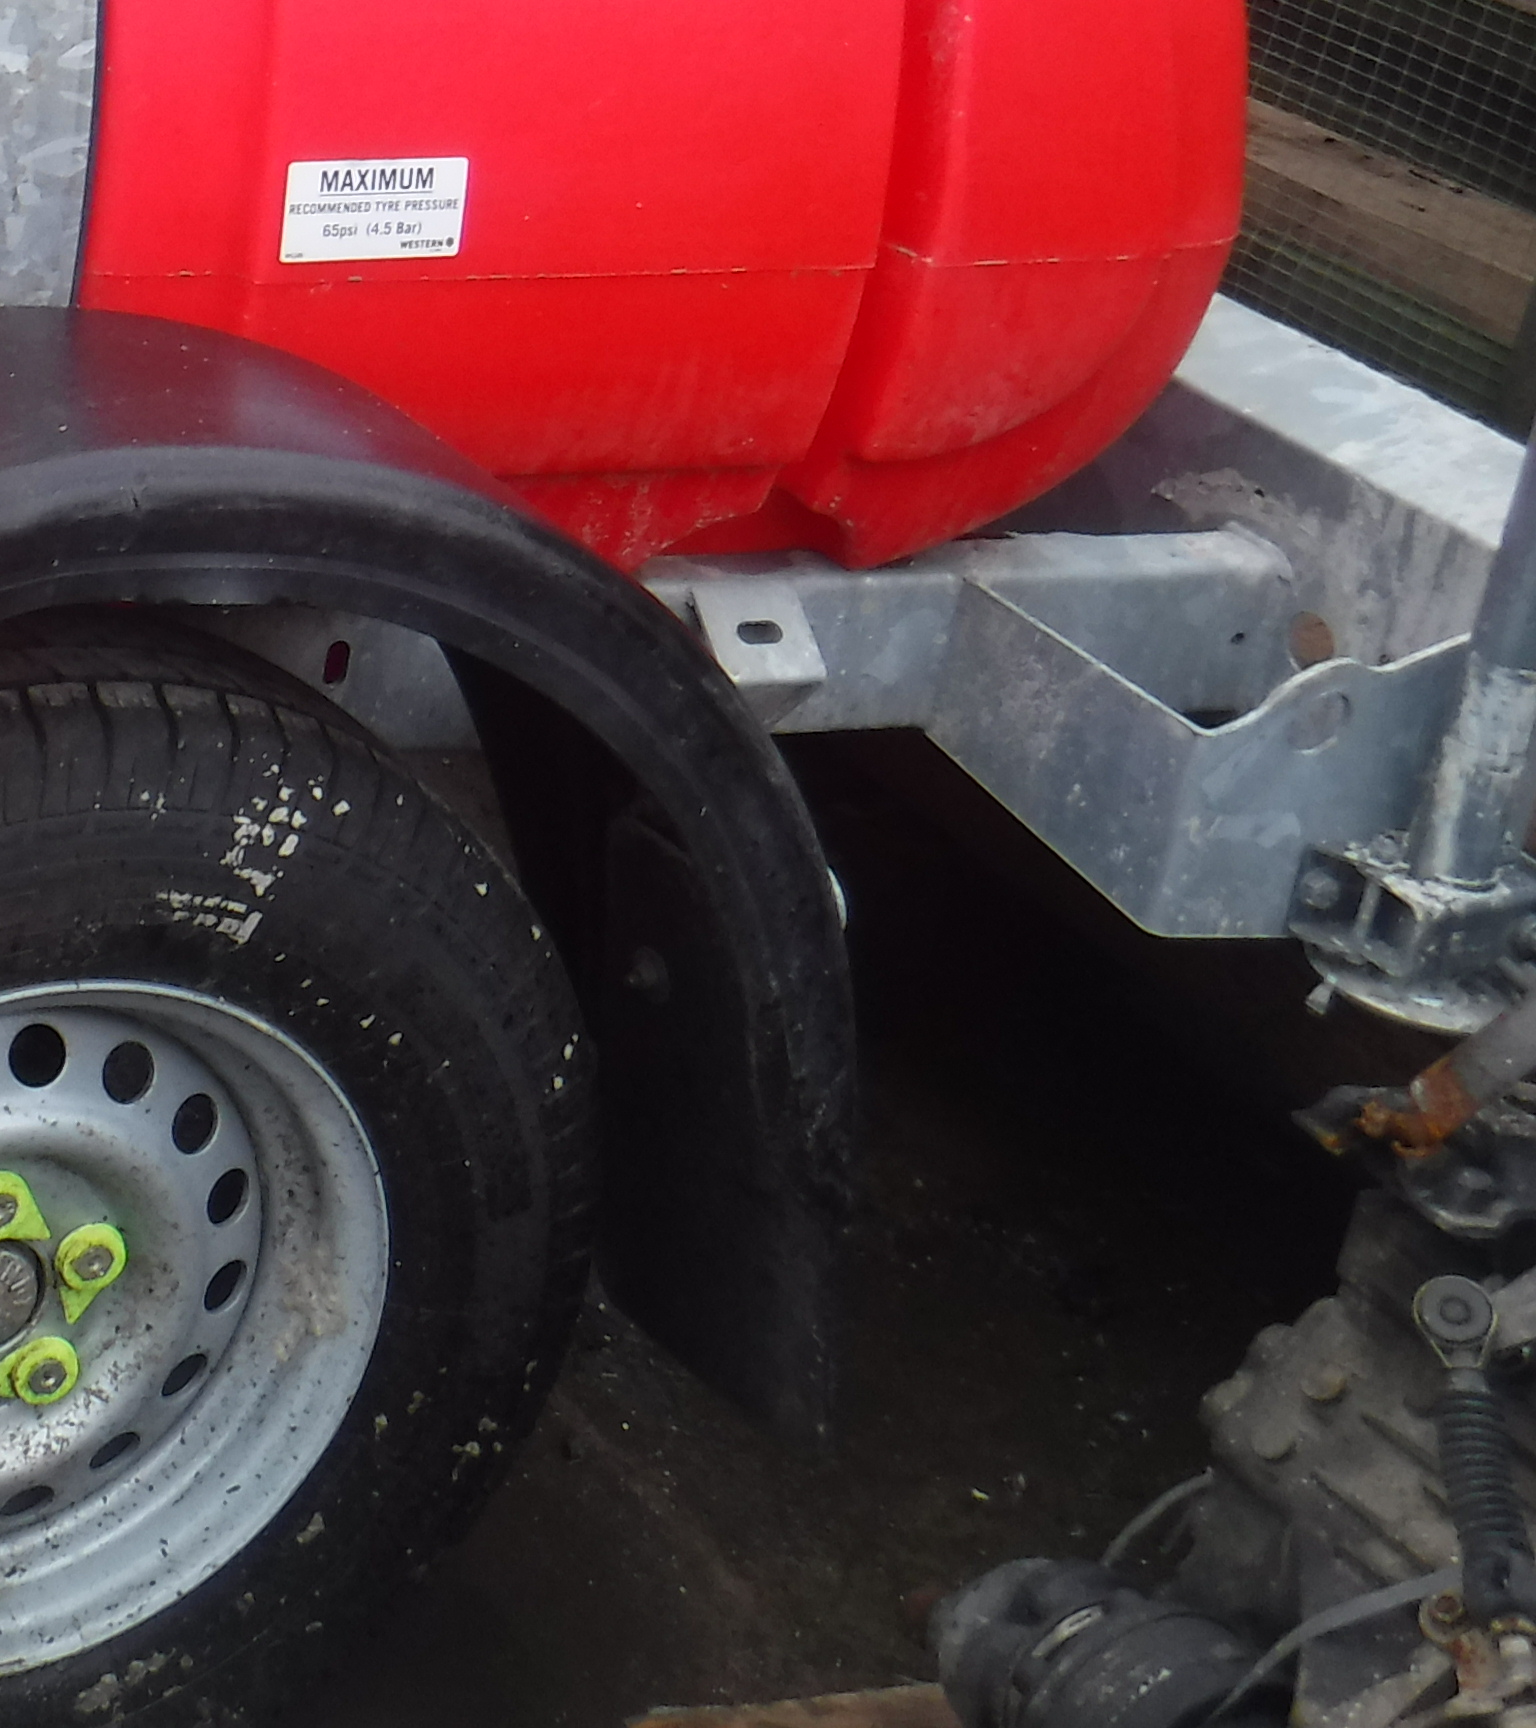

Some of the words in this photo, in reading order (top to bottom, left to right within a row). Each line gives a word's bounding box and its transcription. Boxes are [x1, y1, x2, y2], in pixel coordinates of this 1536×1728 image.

[319, 167, 435, 193] MAXIMUM
[288, 201, 371, 215] RECOMMENDED
[375, 200, 401, 212] TYRE
[404, 198, 460, 211] PRESSURE
[322, 223, 358, 239] 65psi
[366, 221, 392, 237] (4.5
[395, 221, 423, 235] Bar)
[400, 239, 444, 249] WESTERN
